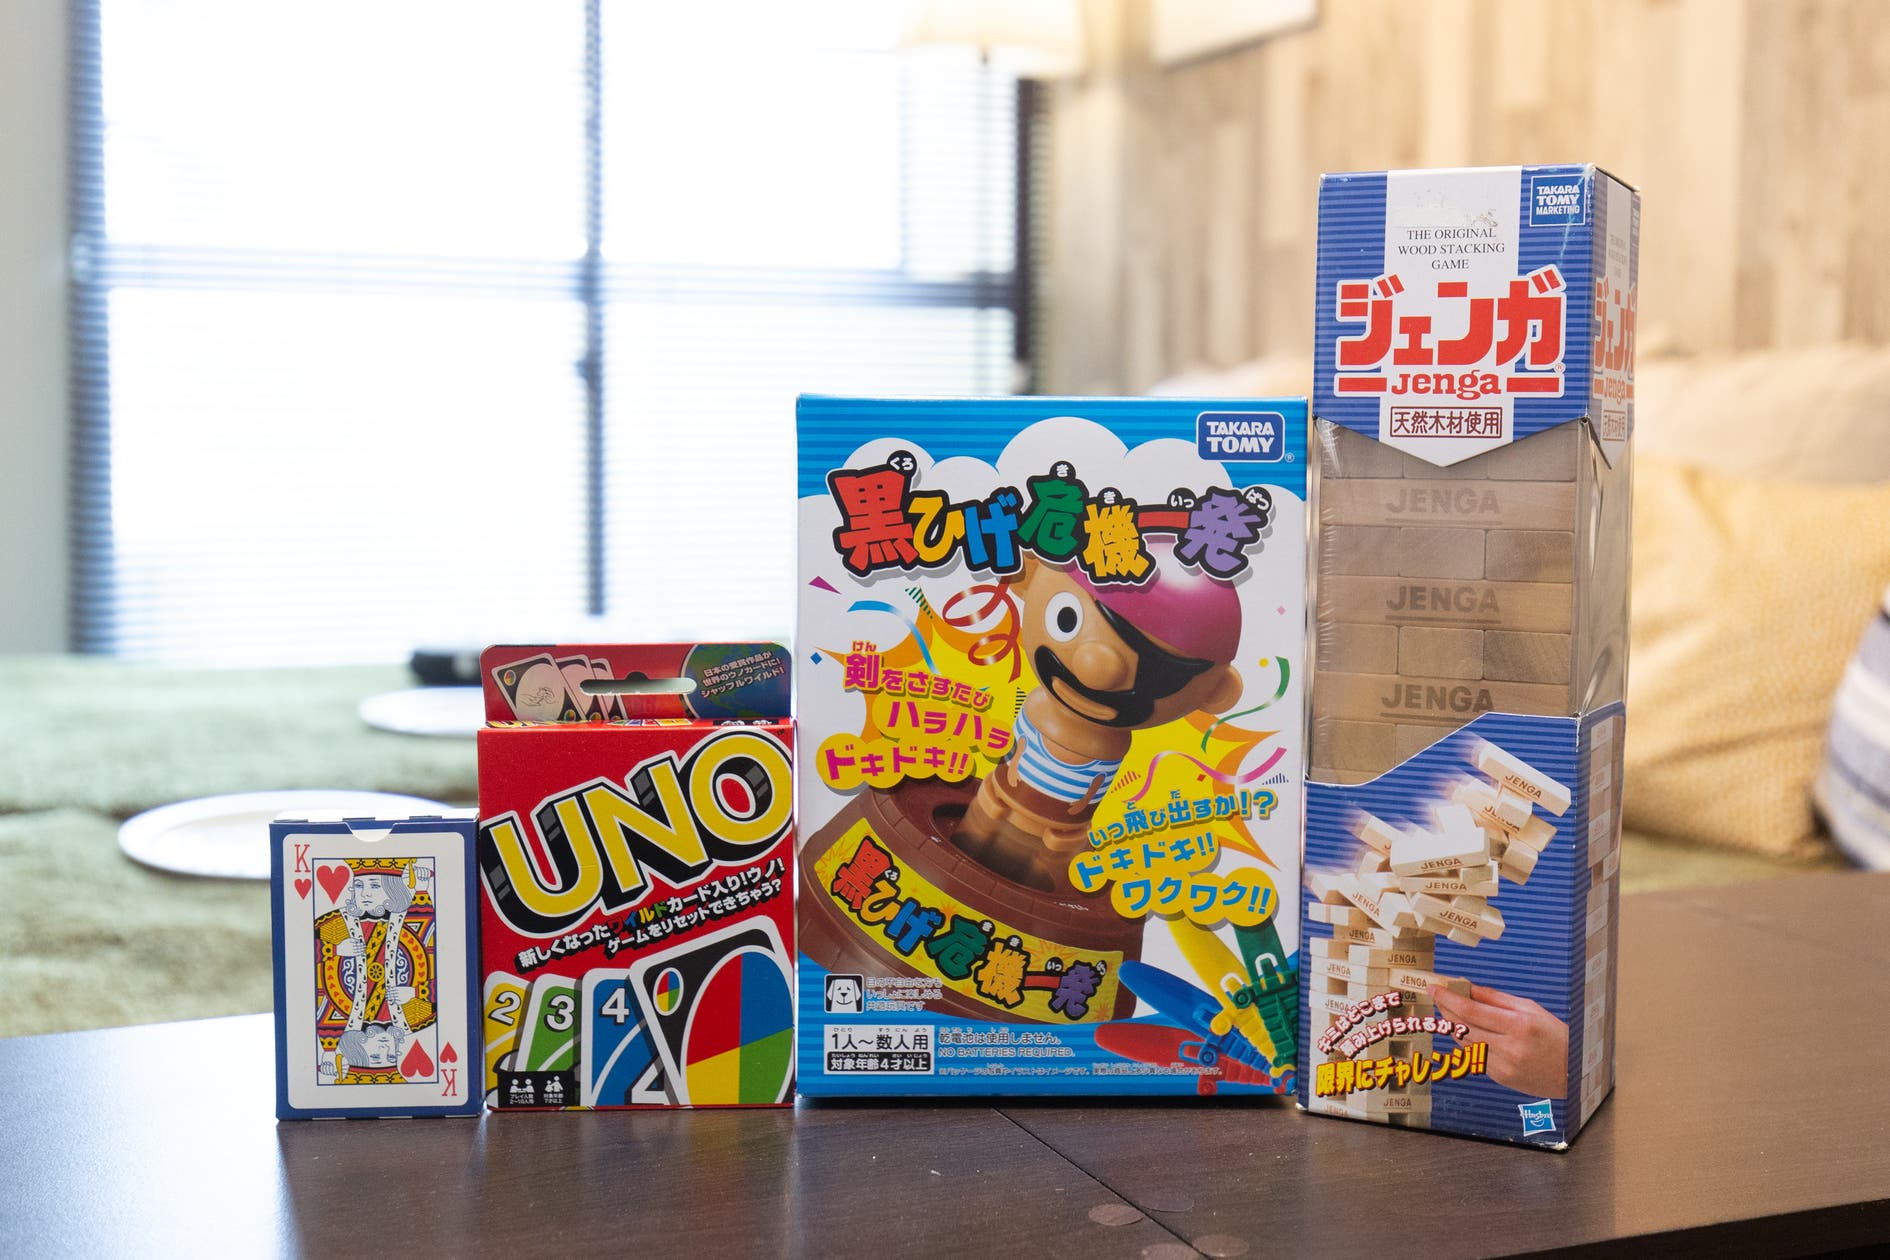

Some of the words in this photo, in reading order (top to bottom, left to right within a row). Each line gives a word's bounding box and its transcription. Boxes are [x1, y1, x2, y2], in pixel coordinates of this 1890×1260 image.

[1536, 184, 1580, 194] TAKARA
[1536, 194, 1580, 206] TOMY
[1535, 205, 1580, 216] MARKETING
[1406, 229, 1431, 240] THE
[1434, 227, 1497, 239] ORIGINAL
[1398, 245, 1437, 255] WOOD
[1440, 243, 1505, 254] STACKING
[1431, 259, 1470, 270] GAME
[1338, 267, 1563, 368] ジェンガ
[1391, 369, 1502, 400] Jenga
[1206, 421, 1275, 436] TAKARA
[1393, 408, 1501, 436] 天然木材使用
[1206, 436, 1275, 453] TOMY
[889, 456, 914, 472] くろ
[1055, 463, 1070, 478] き
[1103, 491, 1115, 504] き
[1386, 487, 1500, 515] JENGA
[832, 468, 1262, 580] 黒ひげ危機一発
[1386, 585, 1500, 613] JENGA
[852, 640, 877, 652] けん
[845, 653, 992, 708] 剣をさすたび
[1381, 683, 1496, 713] JENGA
[887, 700, 1011, 750] ハラハラ
[825, 743, 970, 781] ドキドキ!!
[1504, 773, 1542, 800] JENGA
[482, 730, 792, 930] UNO
[293, 844, 311, 873] K
[1076, 831, 1216, 889] ドキドキ!!
[1420, 857, 1463, 870] JENGA
[1122, 876, 1272, 915] ワクワク!!
[1425, 881, 1468, 891] JENGA
[606, 878, 783, 954] ゲームをリセットできちゃう?
[1352, 891, 1381, 917] JENGA
[832, 838, 1101, 1017] 黒ひげ危機一発
[1440, 909, 1479, 930] JENGA
[1349, 929, 1376, 941] JENGA
[1326, 963, 1351, 976] JENGA
[1388, 953, 1417, 964] JENGA
[1400, 974, 1428, 988] JENGA
[489, 990, 522, 1026] 2
[544, 994, 576, 1031] 3
[600, 987, 630, 1025] 4
[1316, 991, 1401, 1054] キミはどこまで
[938, 1032, 1062, 1045] 乾電池は使用しません。
[830, 1058, 929, 1071] 対象年齢4才以上
[938, 1047, 955, 1058] NO
[957, 1047, 1017, 1058] BATTERIES
[1018, 1047, 1076, 1058] REQUIRED.
[1315, 1041, 1488, 1097] 限界にチャレンジ!!
[441, 1068, 458, 1097] K
[1383, 1098, 1412, 1107] JENGA
